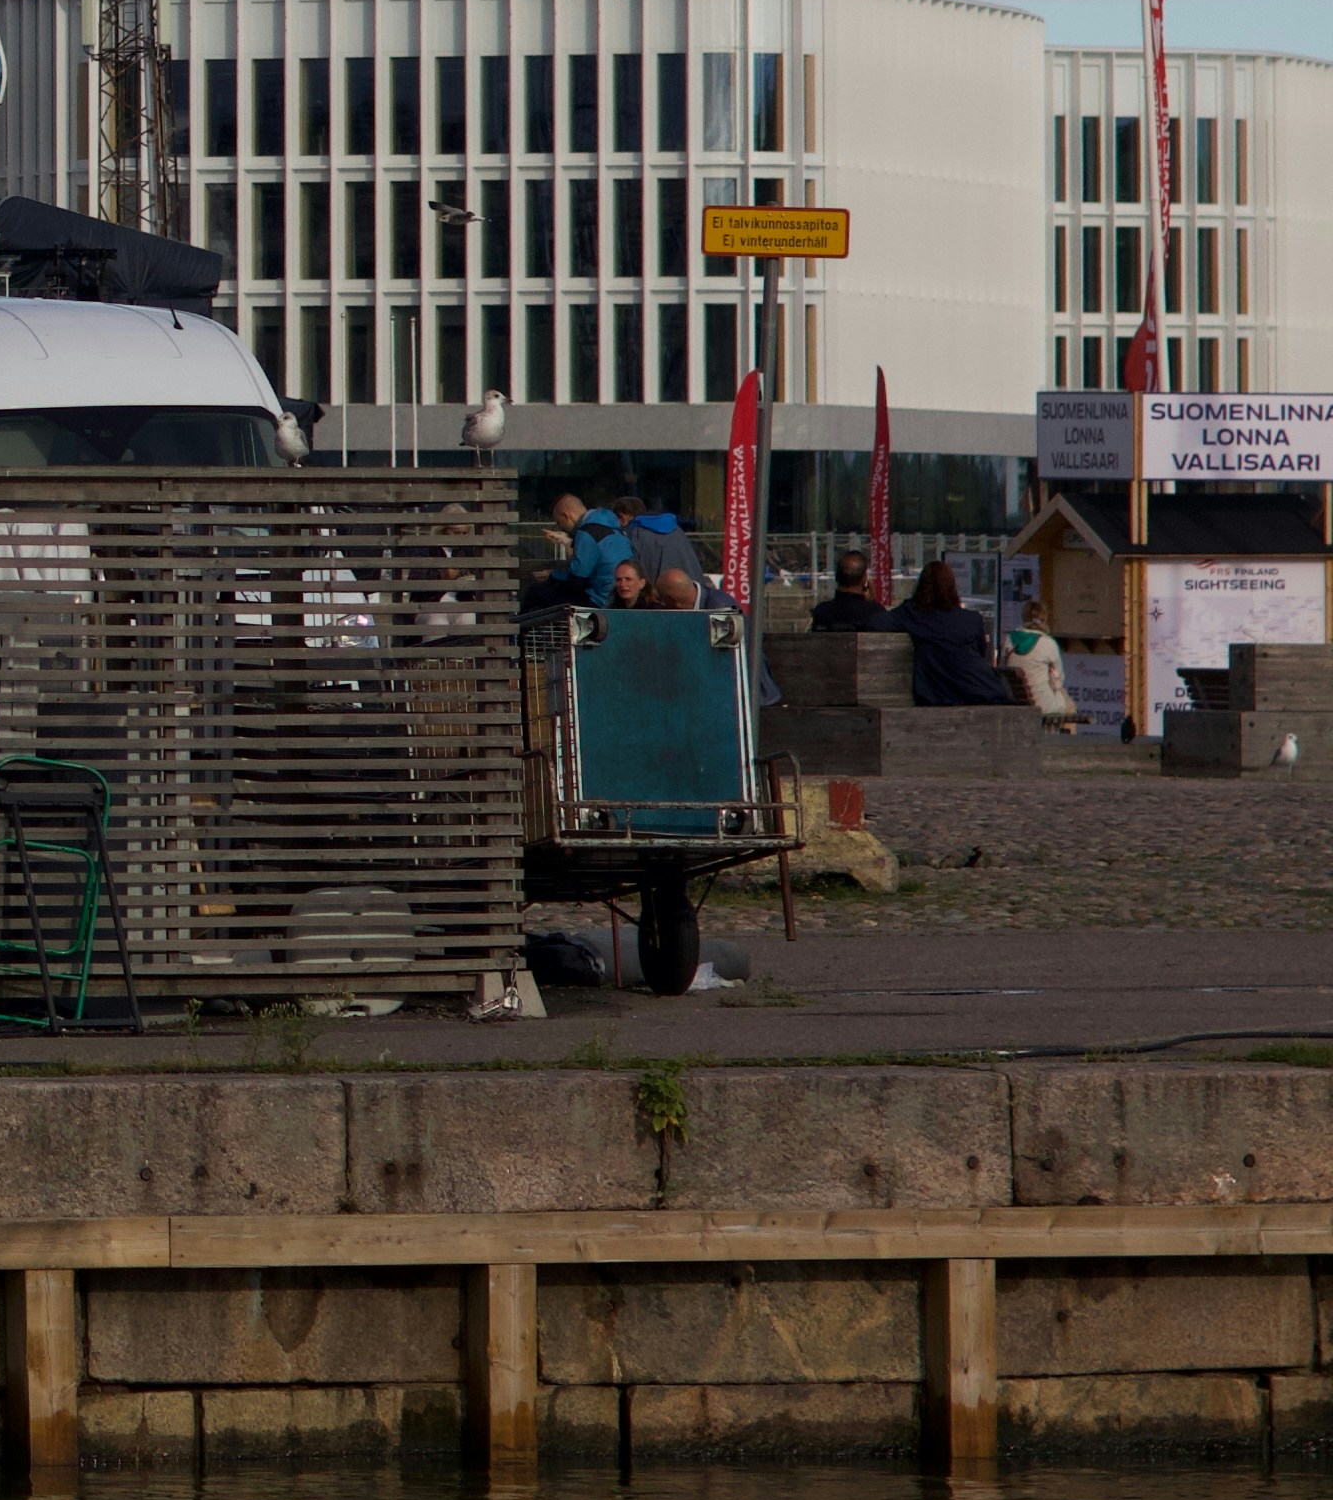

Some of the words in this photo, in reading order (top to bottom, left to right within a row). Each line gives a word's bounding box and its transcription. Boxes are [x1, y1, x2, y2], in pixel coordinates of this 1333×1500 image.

[713, 217, 724, 228] Ei
[729, 217, 839, 232] talvikunnossapitoa
[723, 235, 735, 249] Ej
[740, 236, 828, 248] vinterunderhåll
[1042, 402, 1129, 419] SUOMENLINNA
[1064, 427, 1106, 444] LONNA
[1202, 428, 1290, 446] LONNA
[1051, 452, 1119, 469] VALLISAARI
[1172, 453, 1321, 471] VALLISAARI
[739, 544, 751, 604] LONNA
[1234, 568, 1279, 576] FINLAND
[1184, 579, 1286, 591] SIGHTSEEING
[1082, 687, 1125, 703] ONBOAR
